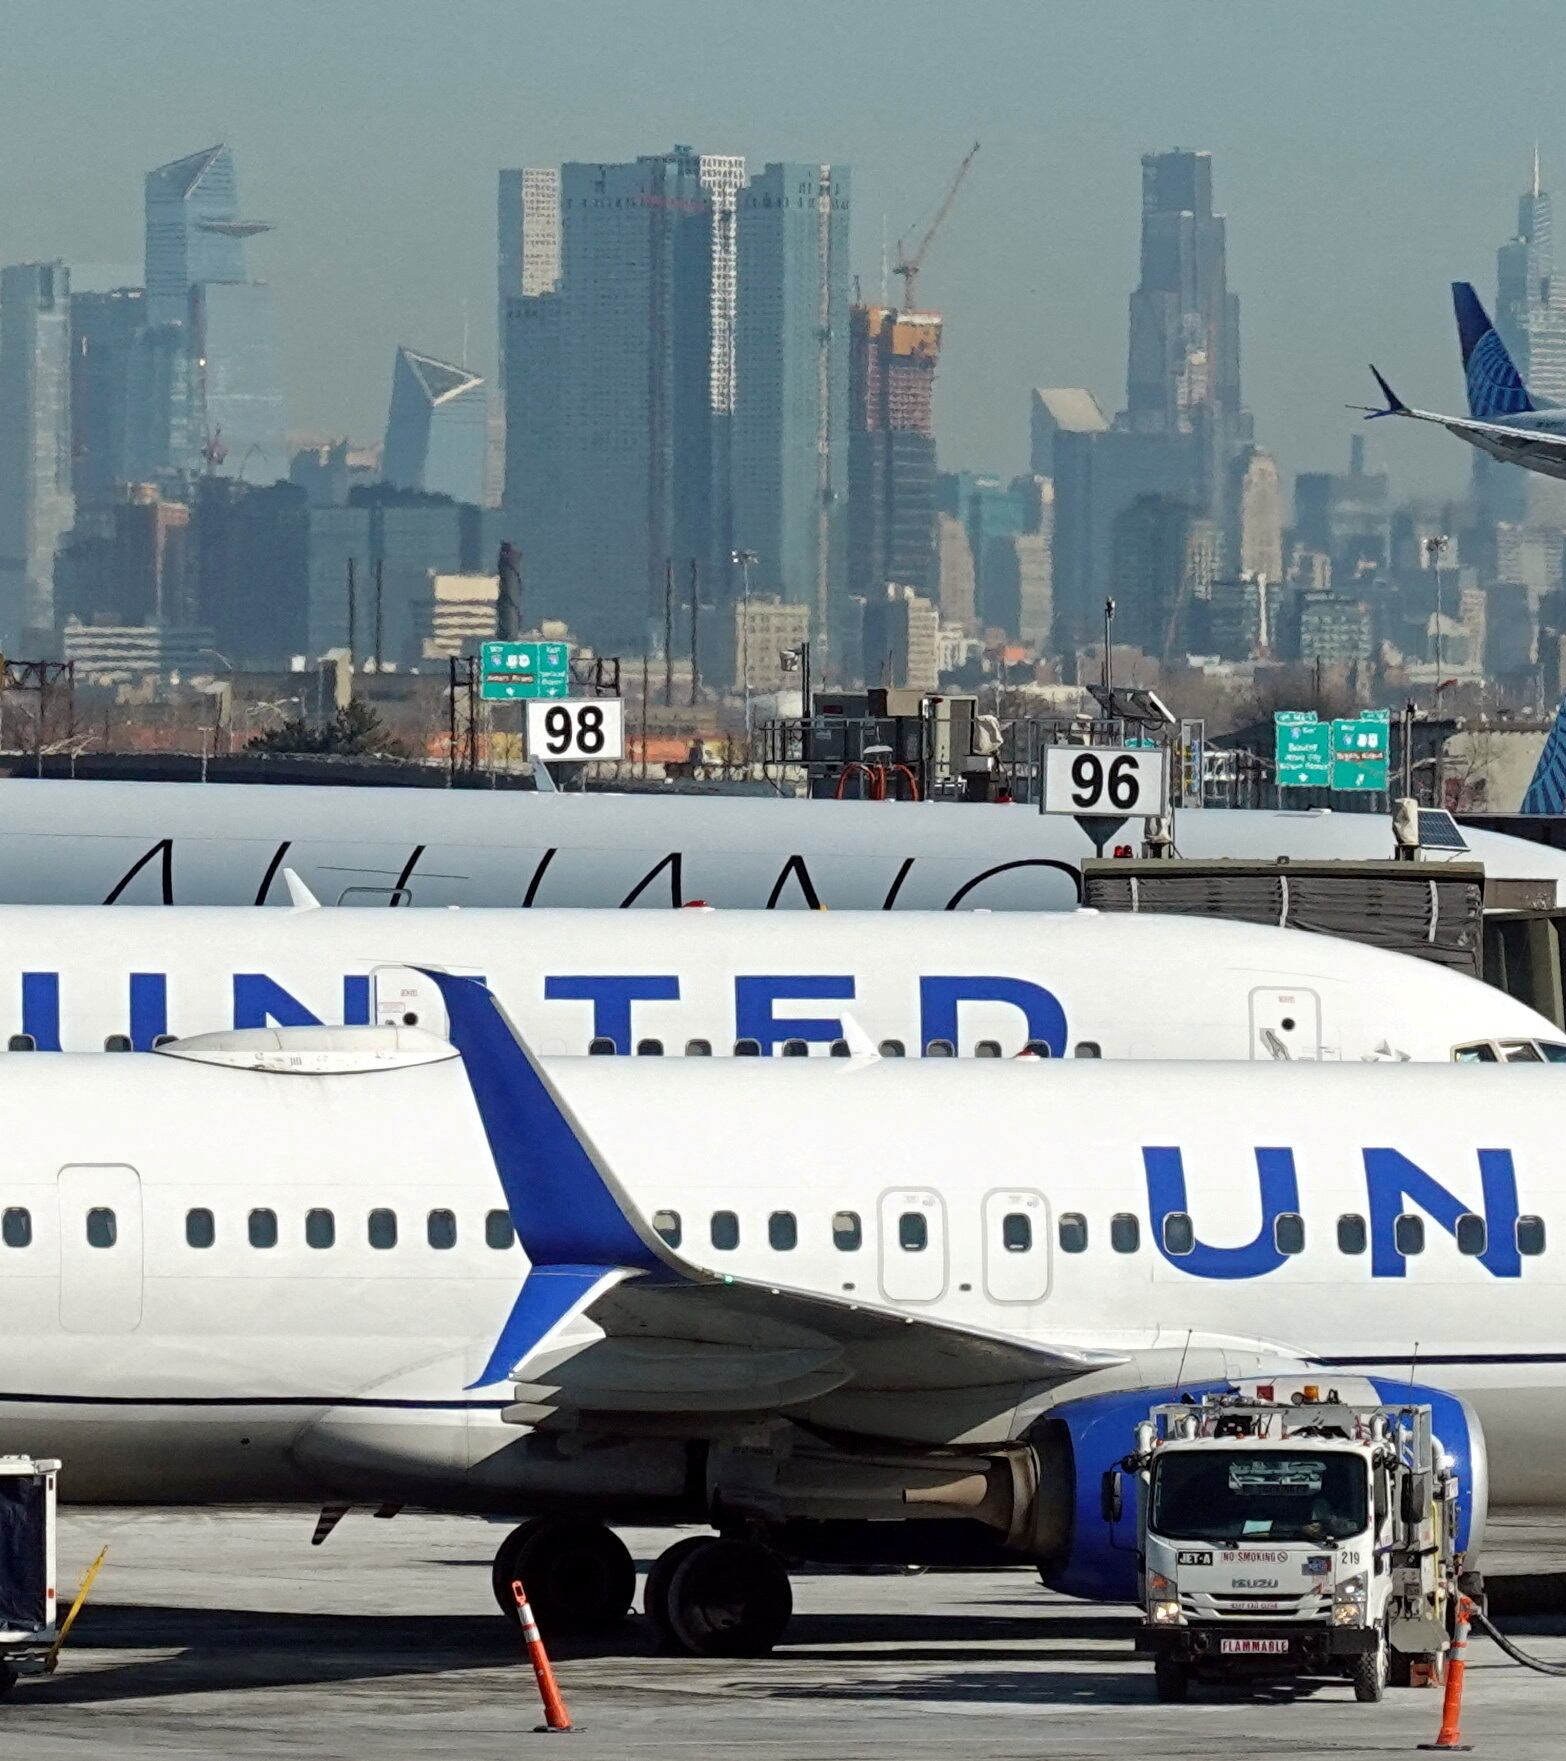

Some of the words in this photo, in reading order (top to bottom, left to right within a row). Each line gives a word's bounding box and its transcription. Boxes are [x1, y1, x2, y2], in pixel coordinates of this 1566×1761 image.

[546, 706, 604, 754] 98
[1072, 754, 1140, 809] 96
[22, 972, 1067, 1058] UTED
[1180, 1553, 1211, 1564] JET-A
[1223, 1552, 1234, 1561] NO
[1238, 1552, 1275, 1562] SMOKING
[1342, 1551, 1360, 1564] 219
[1232, 1579, 1278, 1588] ISUZU
[1223, 1640, 1287, 1652] FLAMMABLE
